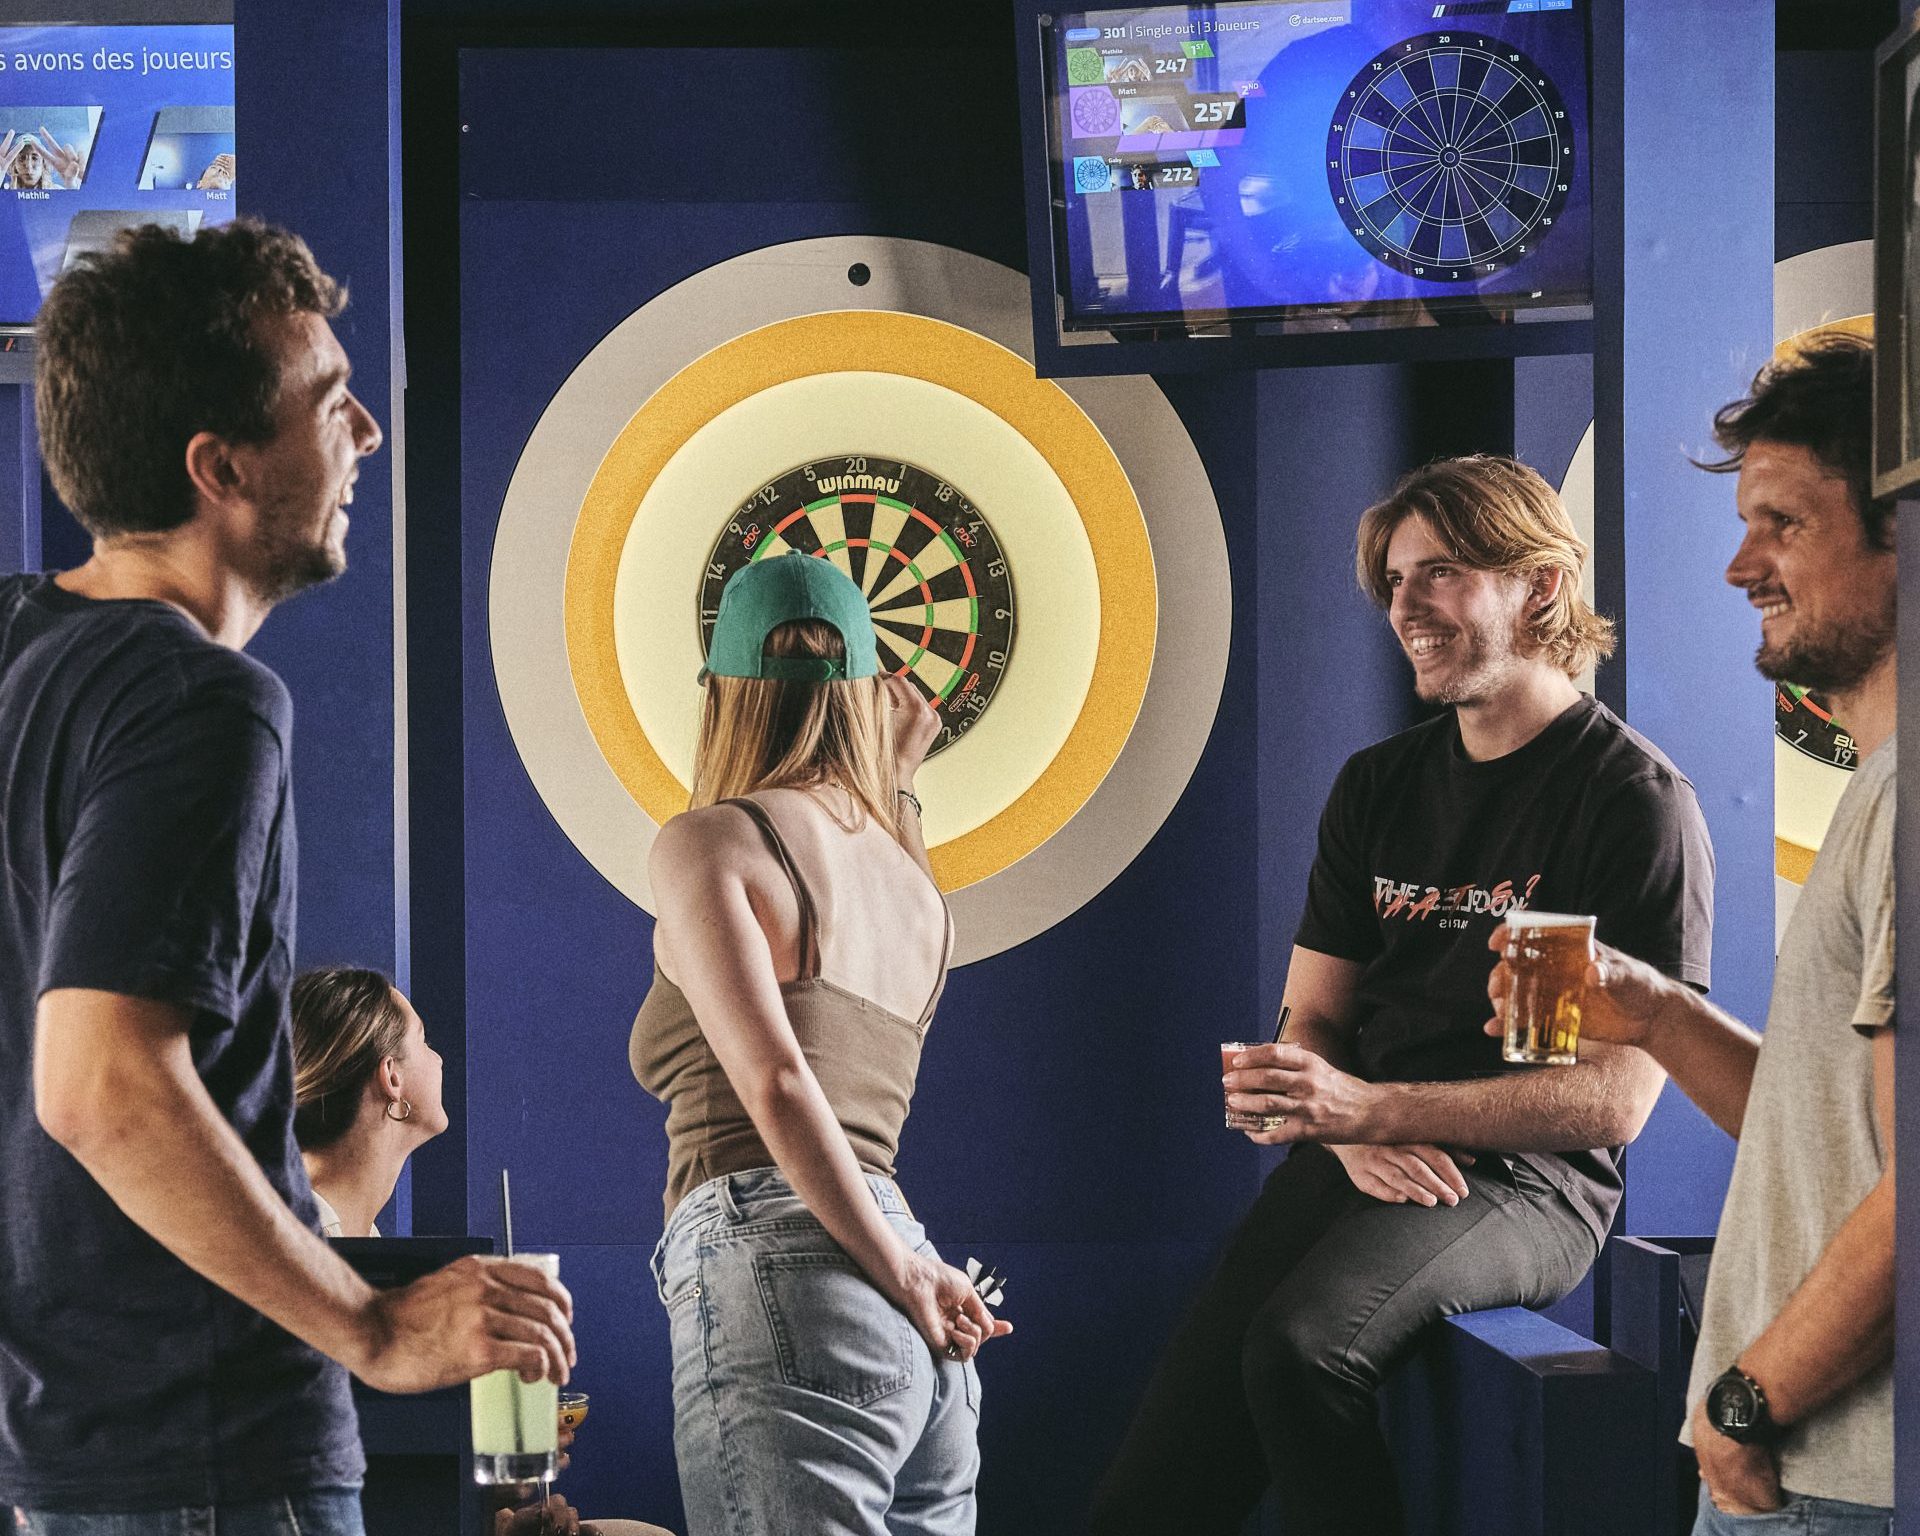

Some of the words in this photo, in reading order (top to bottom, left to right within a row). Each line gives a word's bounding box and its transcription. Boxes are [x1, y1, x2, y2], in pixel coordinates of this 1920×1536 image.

[1302, 15, 1344, 24] dartsee.com
[1103, 27, 1127, 39] 301
[1135, 23, 1172, 39] Single
[1175, 24, 1195, 35] out
[1204, 22, 1211, 33] 3
[1213, 20, 1260, 33] Joueurs
[1439, 35, 1450, 44] 20
[1478, 39, 1483, 47] 1
[1190, 43, 1205, 55] 1ST
[15, 52, 84, 71] avons
[92, 47, 135, 70] des
[141, 46, 232, 76] joueurs
[1509, 54, 1519, 62] 18
[1155, 58, 1187, 74] 247
[1372, 62, 1382, 70] 12
[1241, 82, 1259, 96] 2ND
[1538, 79, 1545, 87] 4
[1118, 87, 1137, 95] Matt
[1193, 101, 1236, 123] 257
[1555, 111, 1564, 119] 13
[1332, 124, 1343, 132] 14
[1564, 147, 1570, 155] 6
[1162, 167, 1193, 182] 272
[206, 191, 228, 200] Matt
[1557, 184, 1567, 192] 10
[1542, 217, 1552, 225] 15
[1354, 228, 1364, 236] 16
[1383, 252, 1389, 260] 7
[1519, 245, 1525, 253] 2
[1414, 267, 1424, 275] 19
[1486, 263, 1495, 271] 17
[1452, 271, 1458, 279] 3
[845, 457, 867, 474] 20
[898, 464, 907, 480] 1
[803, 465, 817, 482] 5
[816, 474, 900, 494] WINMAU
[759, 486, 780, 506] 12
[935, 482, 953, 502] 18
[729, 521, 743, 536] 9
[968, 519, 983, 534] 4
[742, 527, 760, 547] PDC
[957, 527, 975, 548] PDC
[707, 563, 727, 581] 14
[987, 558, 1005, 578] 13
[702, 609, 719, 626] 11
[987, 650, 1005, 669] 10
[967, 692, 987, 713] 15
[941, 726, 956, 743] 2
[1794, 729, 1808, 745] 7
[1833, 733, 1859, 751] BL
[1834, 746, 1852, 765] 19
[1374, 875, 1420, 906] THE
